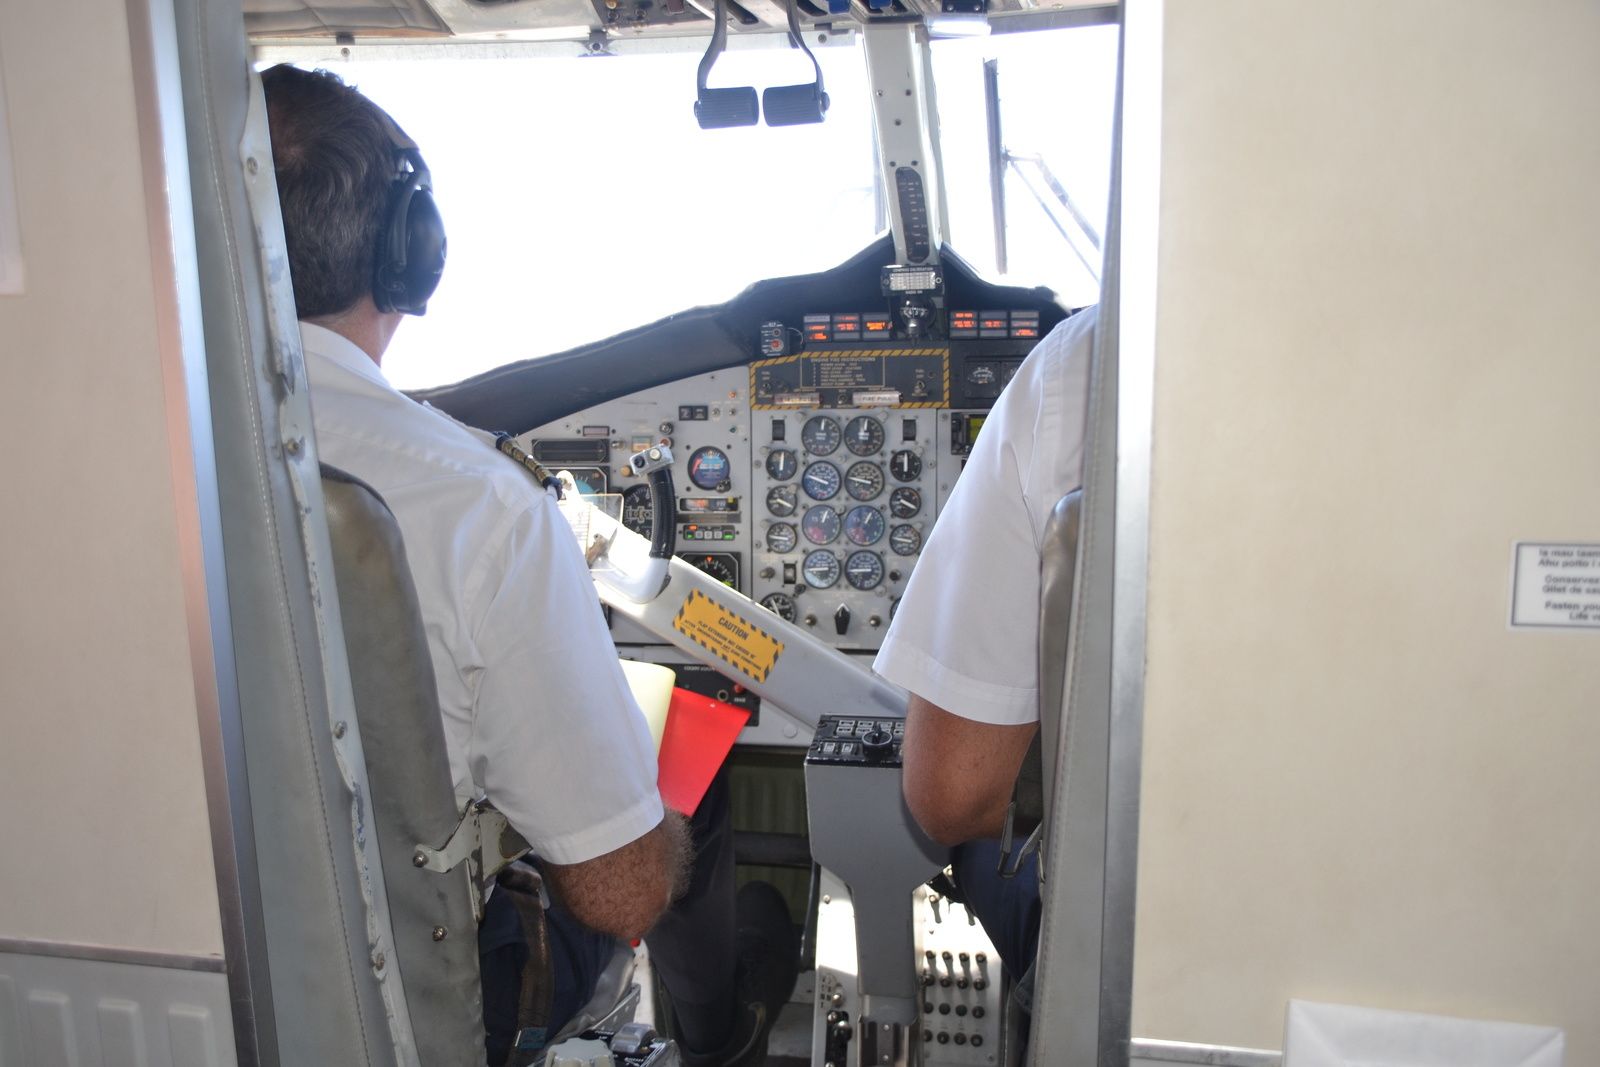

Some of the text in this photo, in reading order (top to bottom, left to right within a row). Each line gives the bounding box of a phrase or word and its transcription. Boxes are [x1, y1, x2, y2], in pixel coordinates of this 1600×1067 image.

[1569, 585, 1582, 593] de
[1544, 601, 1580, 610] Fasten
[1569, 611, 1588, 620] Life
[719, 618, 748, 640] CAUTION
